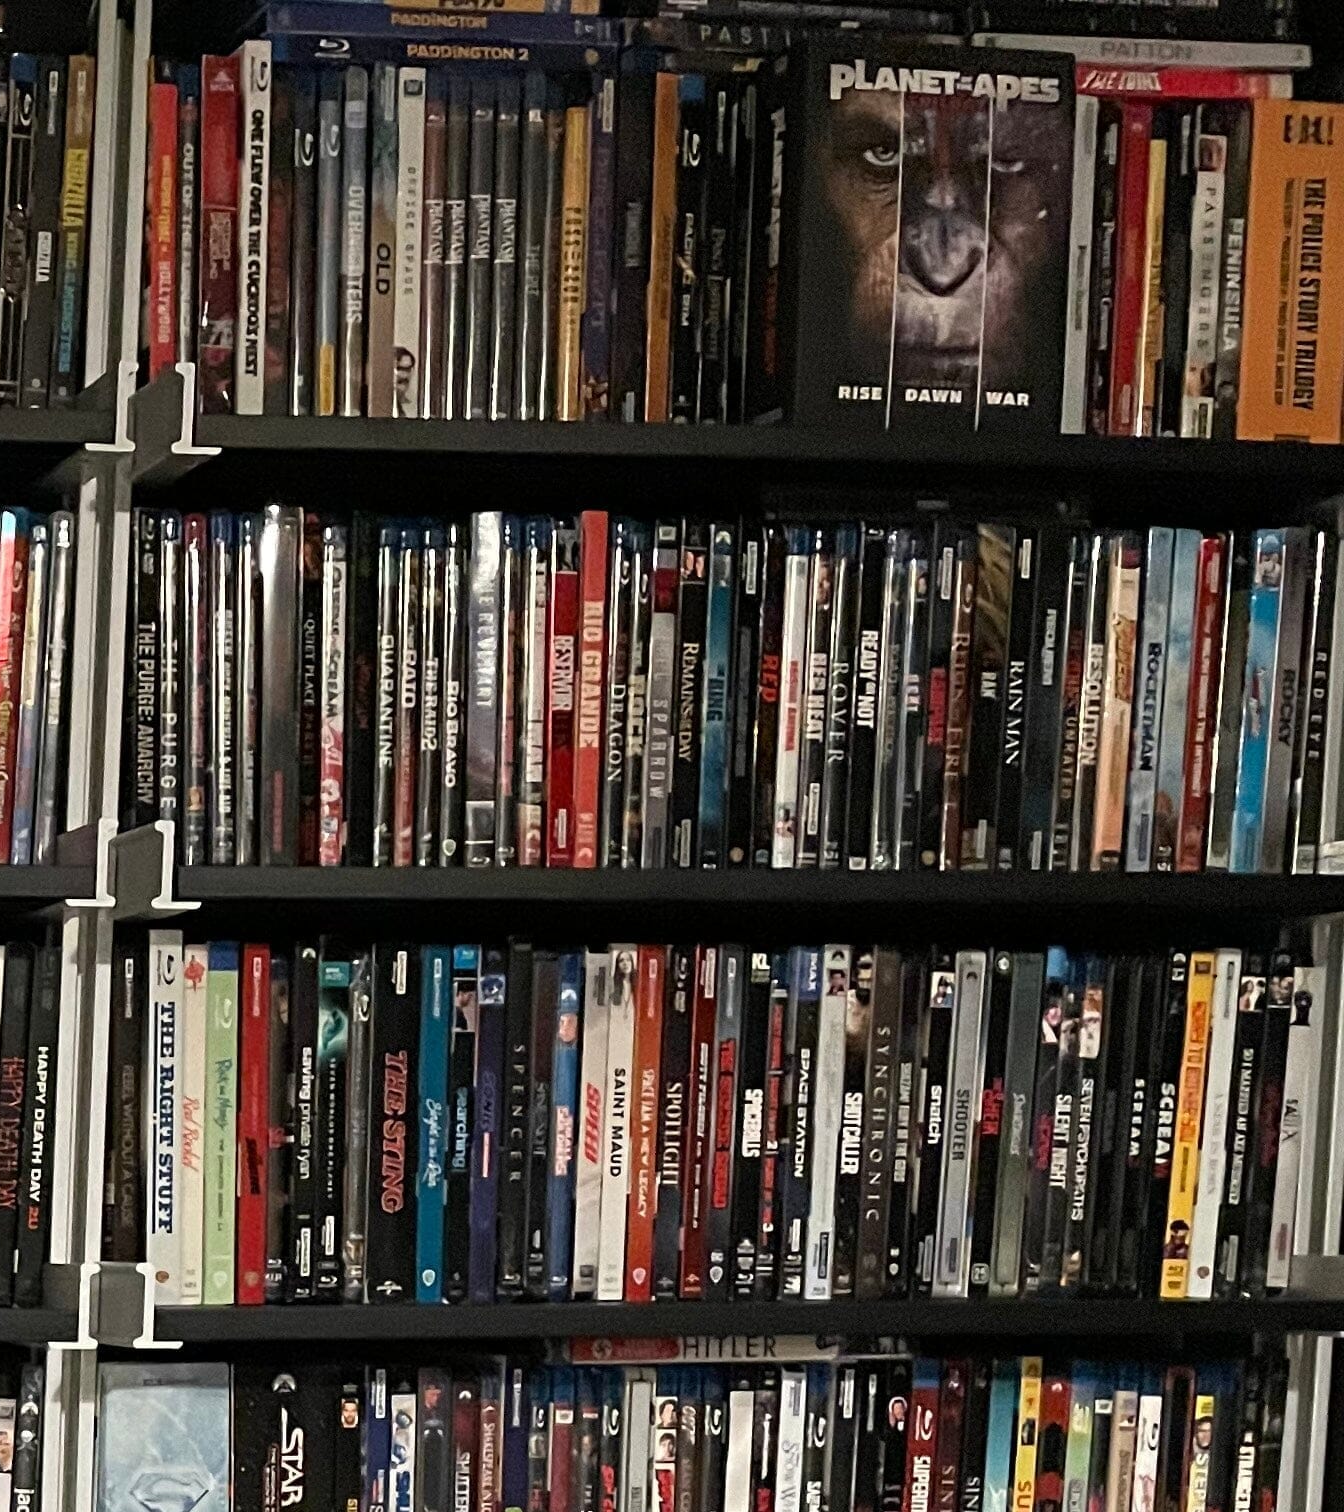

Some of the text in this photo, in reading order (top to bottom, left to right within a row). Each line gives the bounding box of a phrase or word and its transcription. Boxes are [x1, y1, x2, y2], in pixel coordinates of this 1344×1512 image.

[830, 59, 1060, 110] PLANET APES
[374, 241, 390, 296] OLD
[1221, 218, 1245, 352] PENINSULA
[838, 386, 1029, 407] RISE DAWN WAR
[136, 622, 155, 803] THE PURGE: ANARCHY
[579, 601, 602, 748] RIO GRANDE
[1003, 660, 1026, 764] RAIN MAN
[157, 1002, 176, 1233] THE RIGHT STUFF
[609, 1068, 627, 1177] SAINT MAUD
[927, 1084, 944, 1145] snatch
[952, 1088, 971, 1161] SHOOTER
[281, 1409, 302, 1507] STAR
